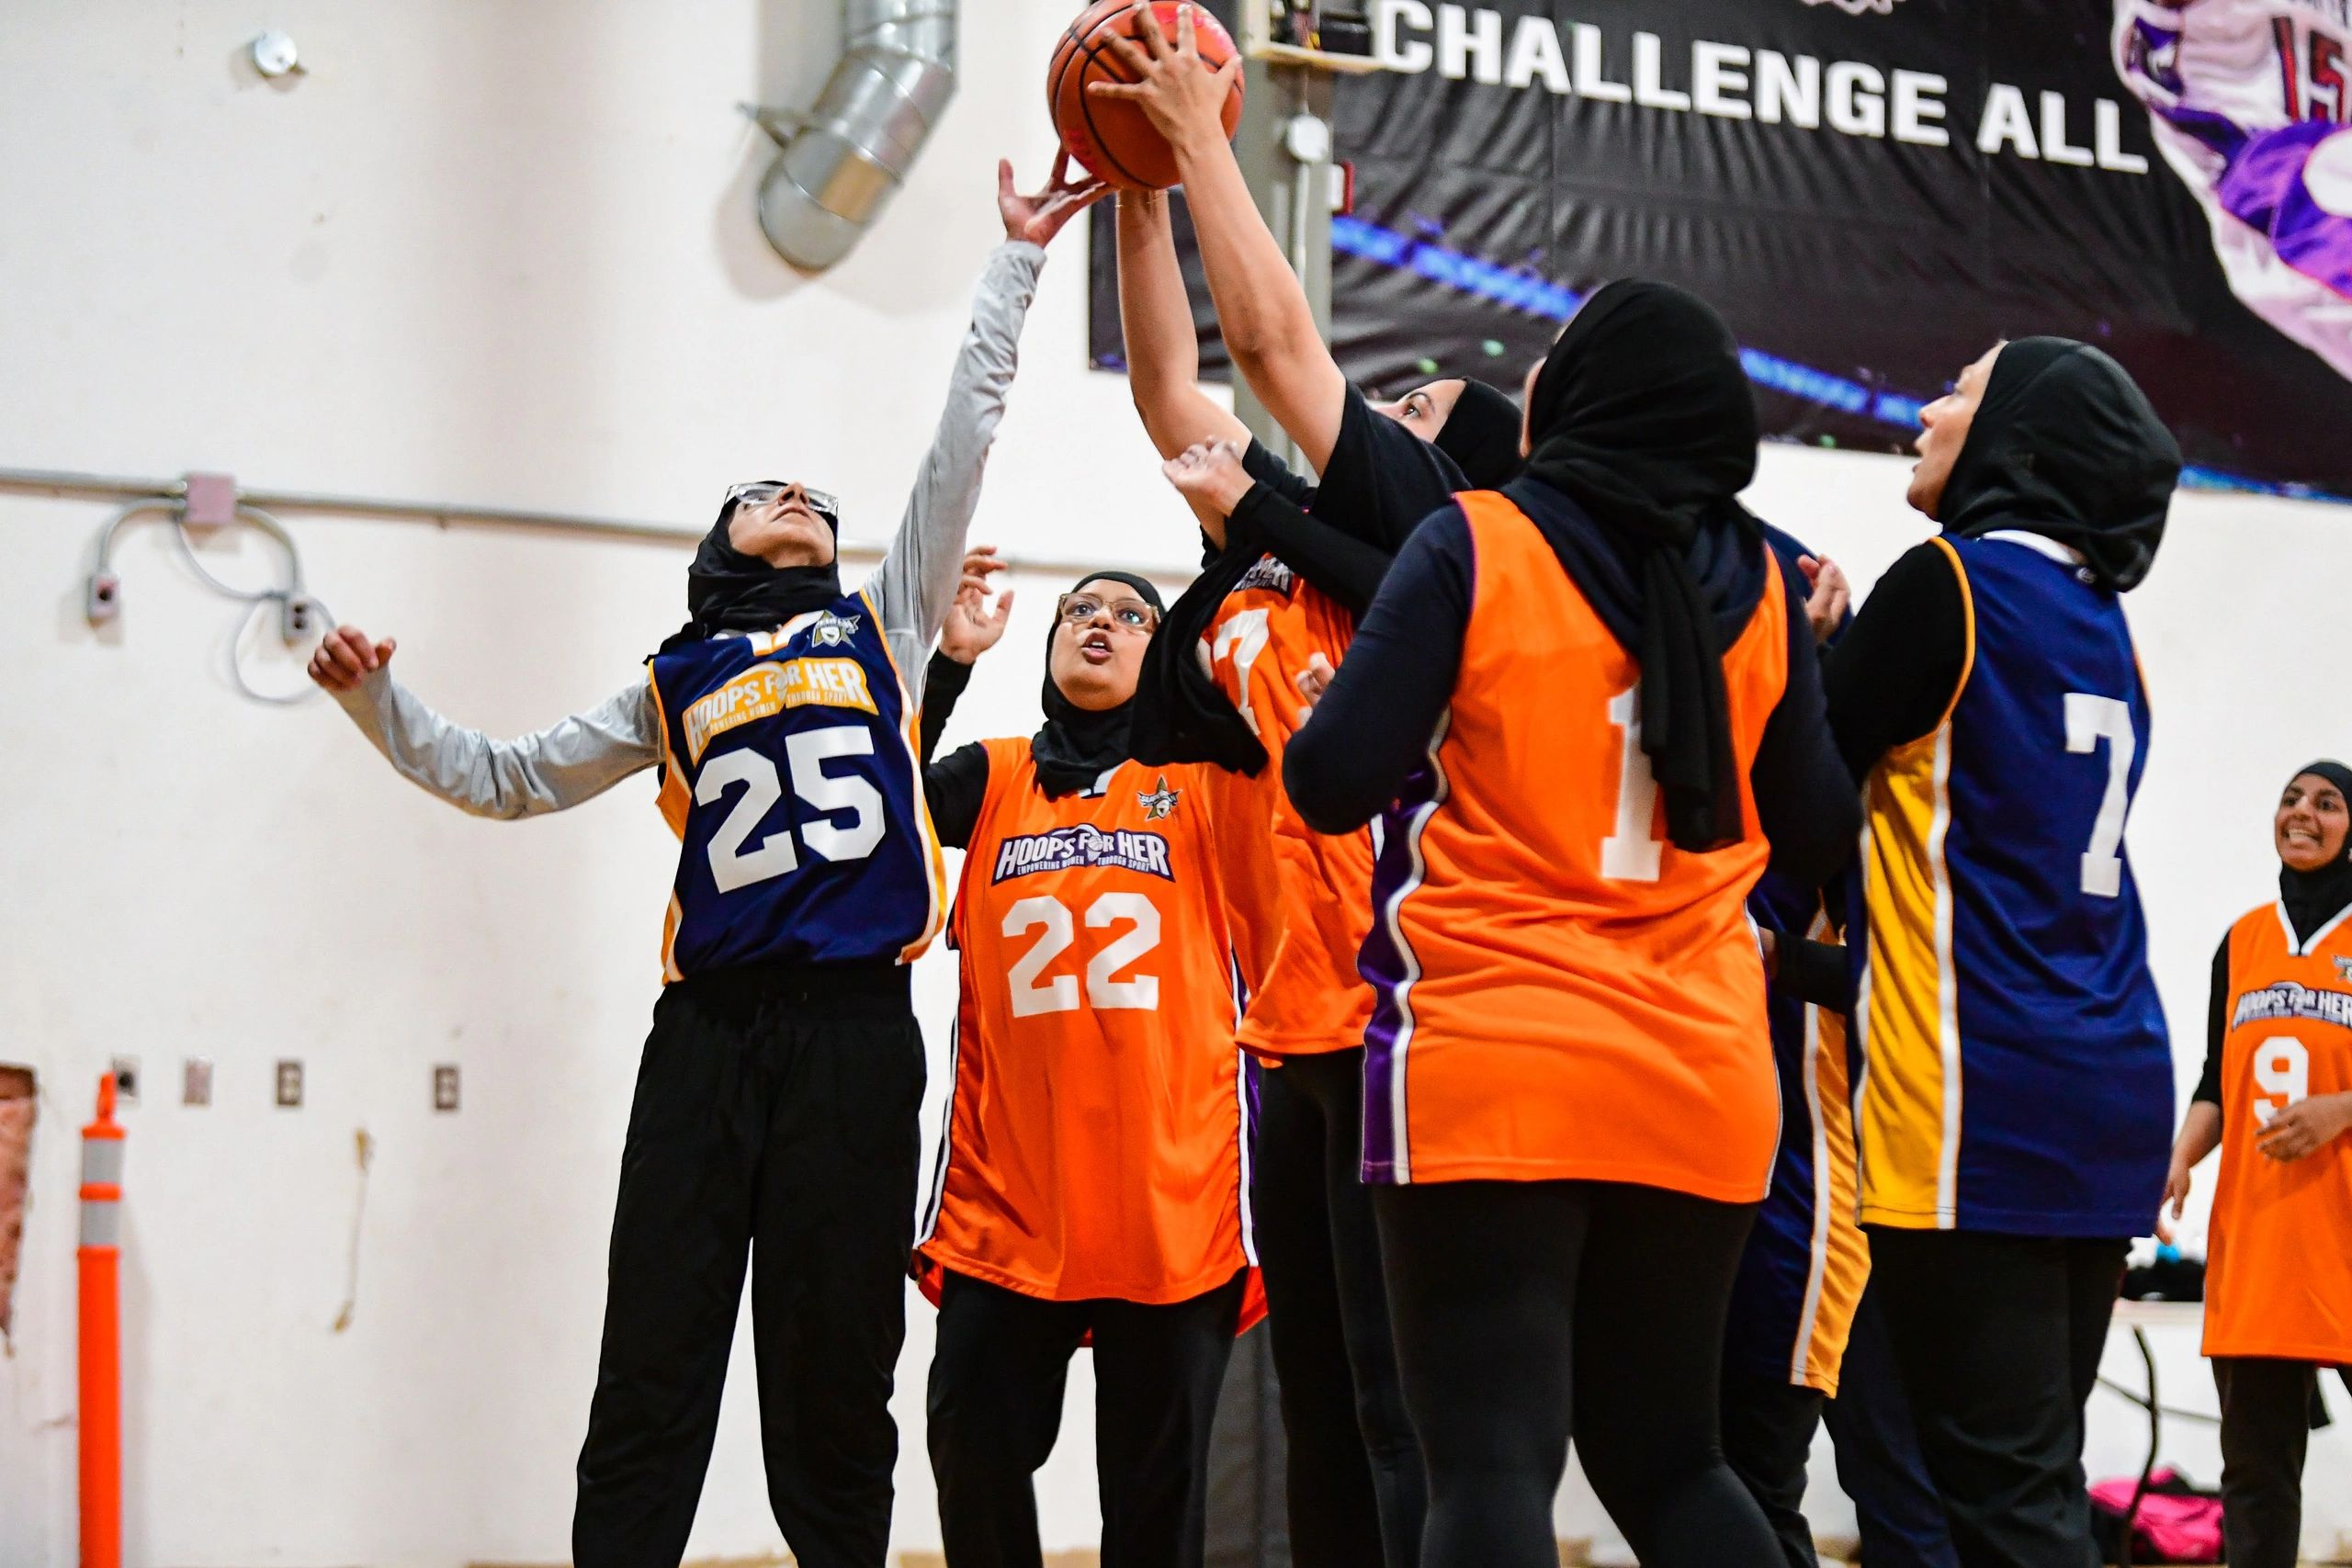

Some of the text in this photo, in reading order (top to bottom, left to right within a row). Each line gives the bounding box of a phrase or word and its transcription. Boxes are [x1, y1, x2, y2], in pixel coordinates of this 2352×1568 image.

[1377, 0, 2148, 174] CHALLENGE ALL
[687, 680, 762, 759] HOOPS
[805, 662, 871, 707] HER
[695, 726, 886, 895] 25
[1601, 684, 1663, 882] 1
[2064, 693, 2136, 897] 7
[995, 836, 1076, 880] HOOPS
[1117, 831, 1170, 875] HER
[1017, 860, 1060, 875] EMPOWERING
[1061, 854, 1085, 868] WOMEN
[1127, 859, 1149, 873] SPORT
[1001, 892, 1160, 1019] 22
[2254, 1036, 2309, 1127] 9
